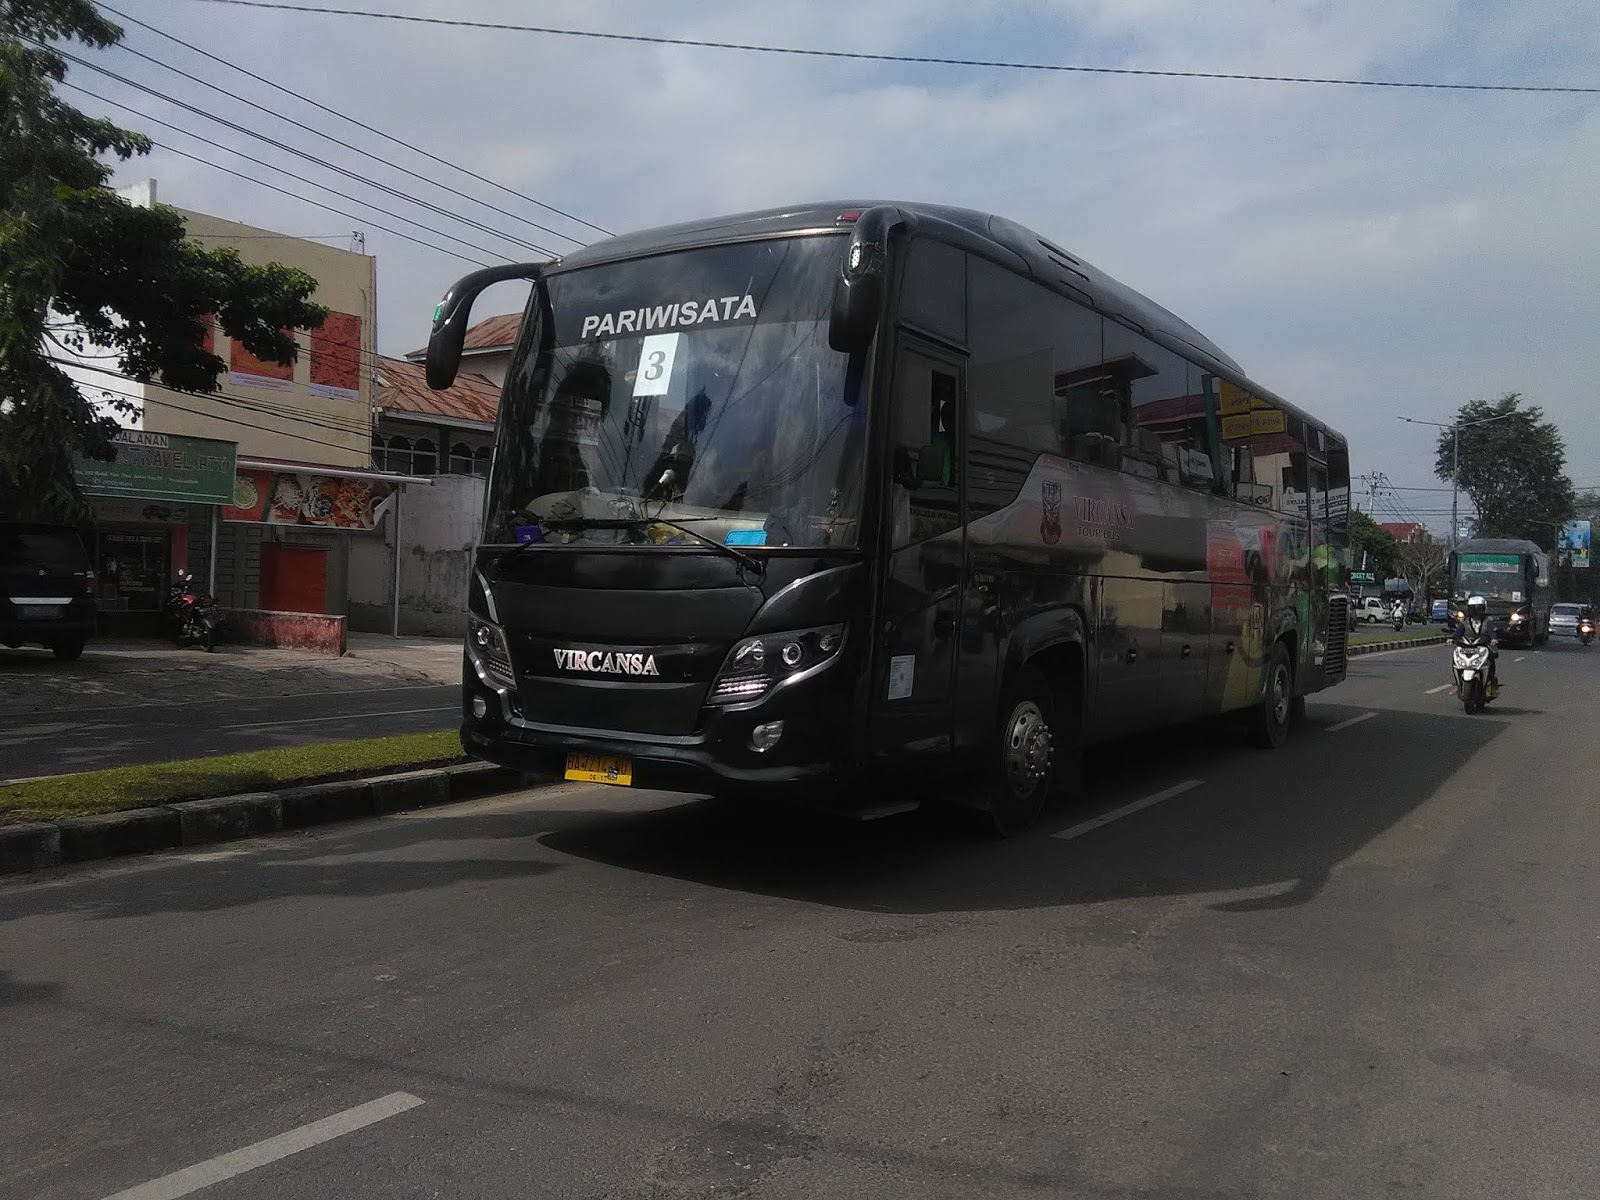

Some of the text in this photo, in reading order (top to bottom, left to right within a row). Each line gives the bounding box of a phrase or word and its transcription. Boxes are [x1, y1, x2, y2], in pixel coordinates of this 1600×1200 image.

[581, 294, 757, 339] PARIWISATA
[645, 350, 666, 381] 3
[130, 447, 192, 470] TRAVEL
[1073, 495, 1134, 530] VIRCANSA
[1078, 526, 1120, 541] TOUR BUS
[553, 648, 660, 676] VIRCANSA
